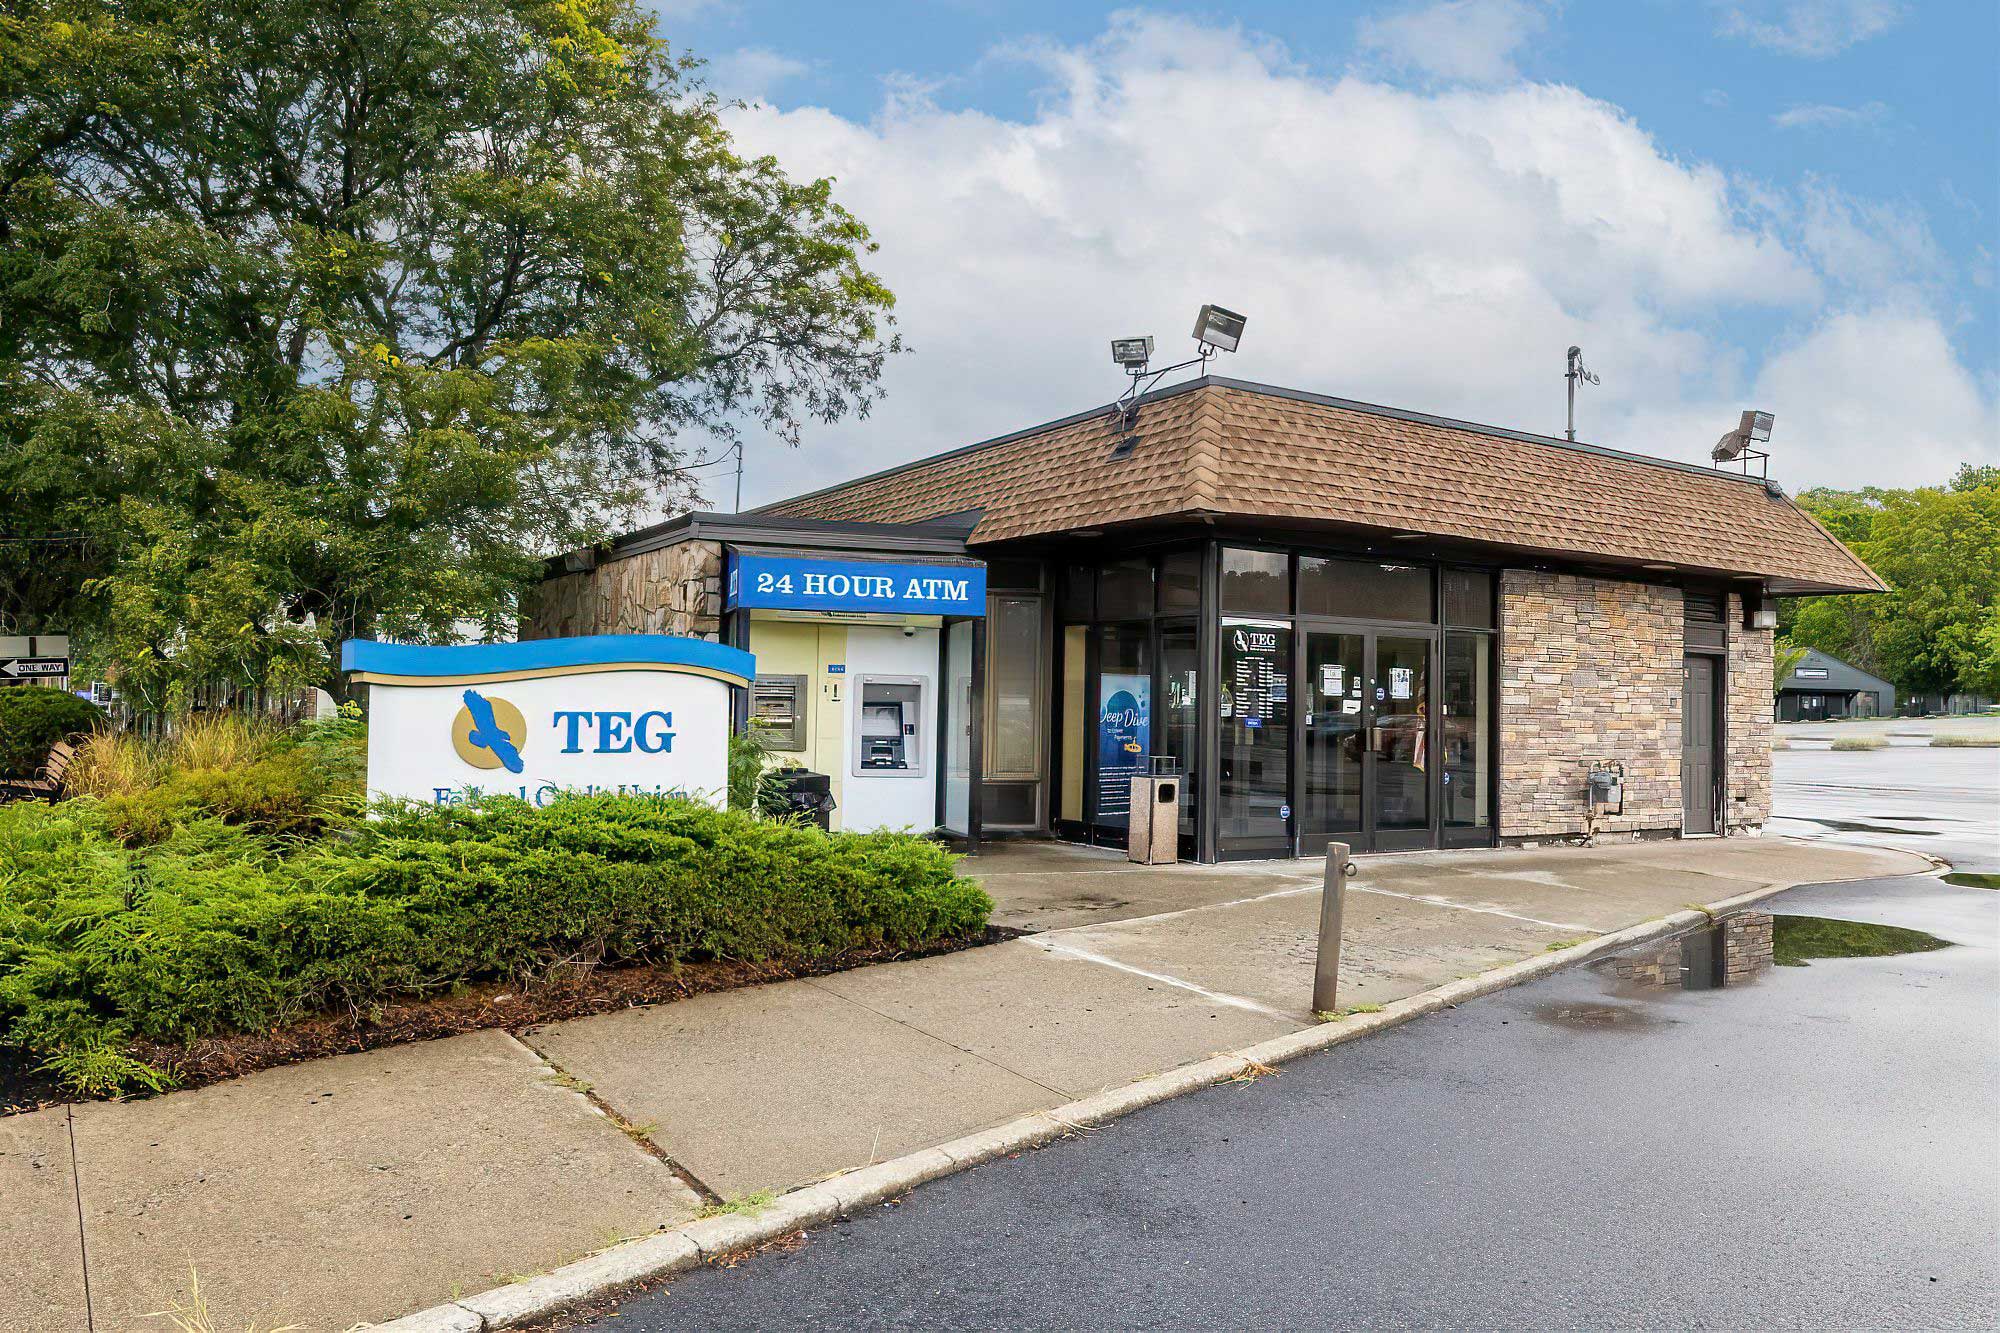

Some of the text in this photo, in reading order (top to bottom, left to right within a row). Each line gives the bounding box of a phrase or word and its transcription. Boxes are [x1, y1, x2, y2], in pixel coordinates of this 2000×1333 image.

[756, 572, 969, 601] 24 HOUR ATM
[1249, 633, 1276, 646] TEG
[18, 663, 61, 672] ONE WAY
[1124, 708, 1149, 728] Dive
[553, 710, 677, 754] TEG
